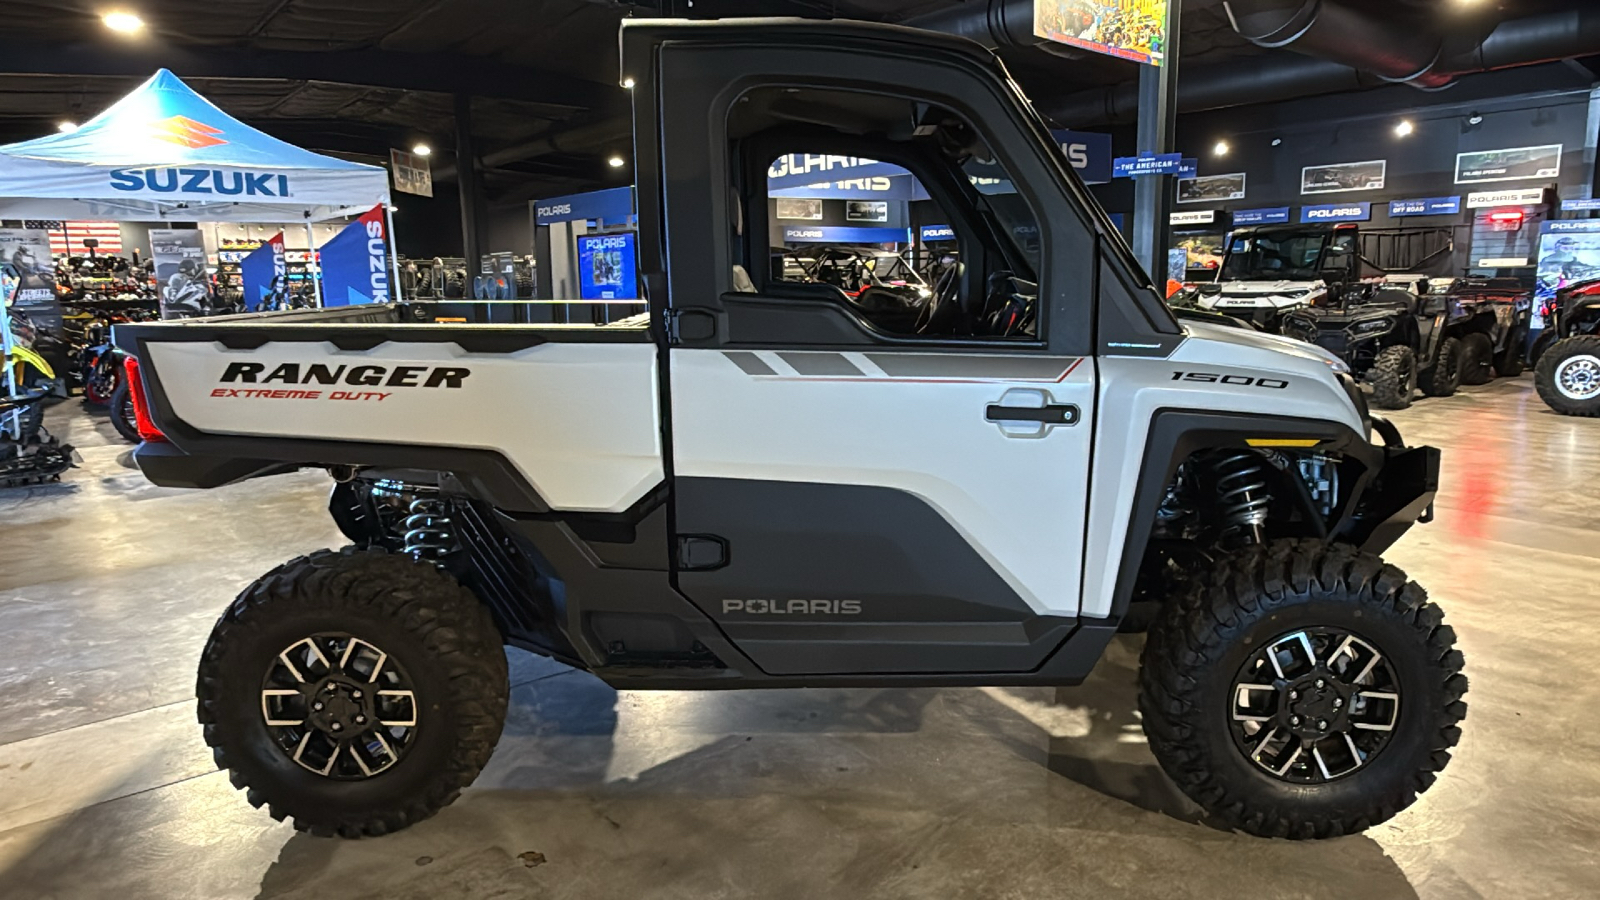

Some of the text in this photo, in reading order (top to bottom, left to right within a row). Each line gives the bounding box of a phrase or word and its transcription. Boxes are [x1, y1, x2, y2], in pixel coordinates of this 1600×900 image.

[1121, 160, 1173, 171] THE AMERICAN
[109, 167, 289, 197] SUZUKI
[1469, 194, 1518, 204] POLARIS
[537, 203, 571, 218] POLARIS
[1307, 207, 1362, 218] POLARIS
[787, 230, 823, 238] POLARIS
[586, 236, 626, 250] POLARIS
[219, 362, 471, 388] RANGER
[1171, 371, 1289, 389] 1500
[210, 388, 393, 401] EXTREME DUTY
[722, 599, 863, 614] POLARIS
